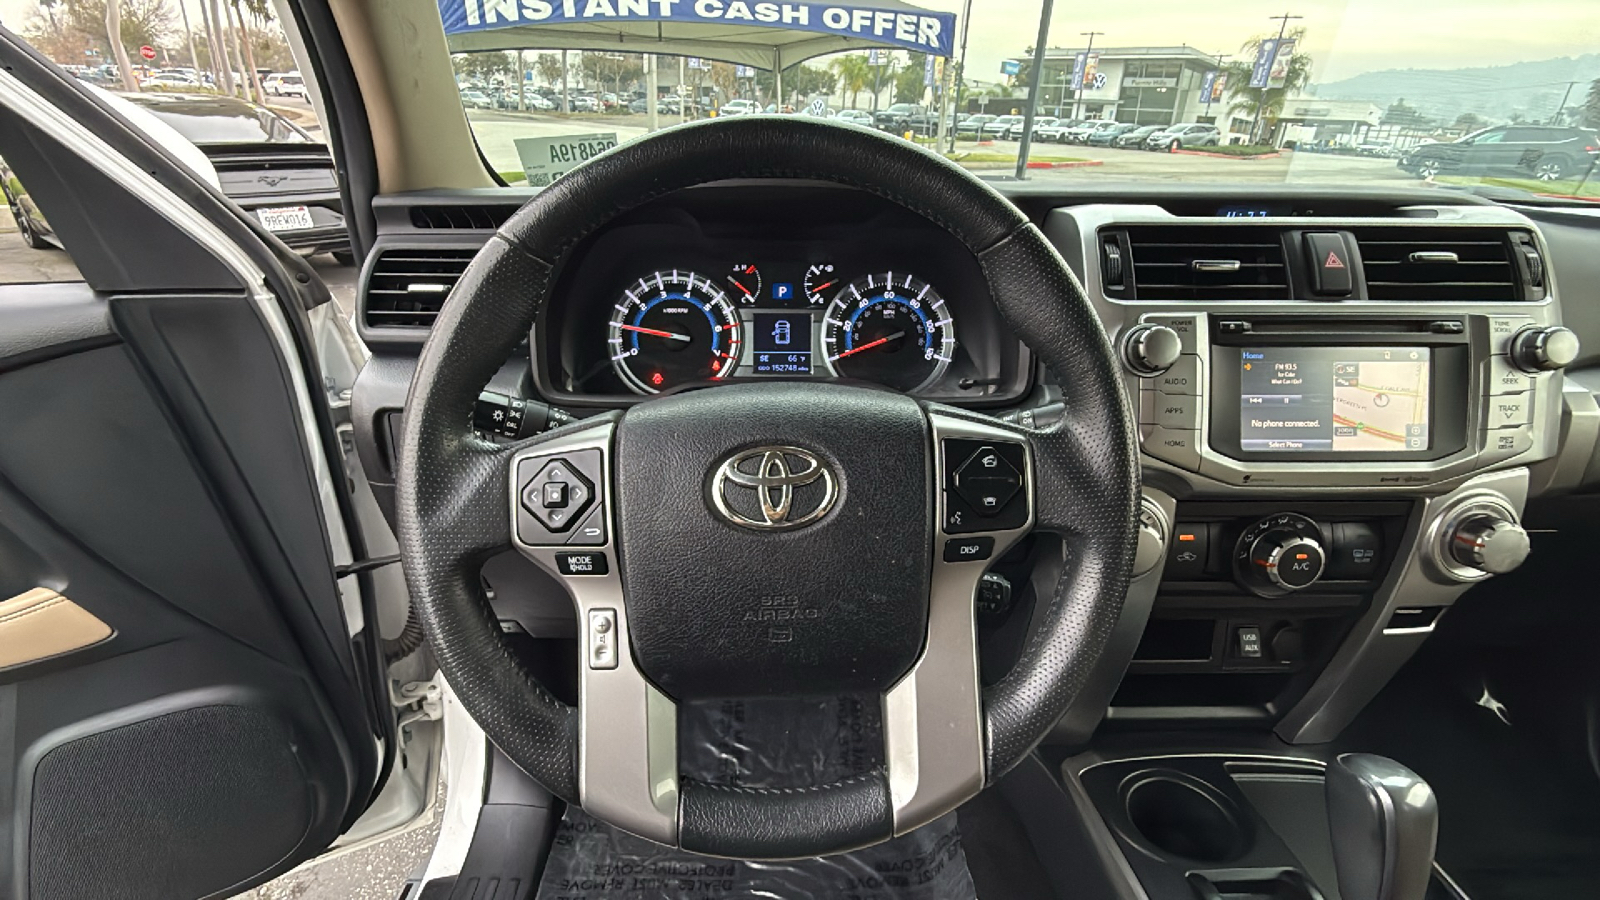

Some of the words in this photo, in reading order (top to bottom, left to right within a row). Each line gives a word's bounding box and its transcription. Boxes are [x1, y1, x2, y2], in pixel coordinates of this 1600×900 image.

[464, 0, 680, 25] INSTANT
[694, 0, 809, 25] CASH
[822, 8, 941, 48] OFFER
[660, 291, 667, 299] 3
[683, 291, 691, 299] 4
[778, 286, 787, 297] P
[883, 291, 895, 299] 60
[640, 302, 648, 311] 2
[703, 303, 712, 311] 5
[859, 298, 869, 308] 40
[909, 298, 920, 309] 80
[714, 325, 722, 333] 6
[843, 320, 853, 332] 20
[630, 348, 638, 356] 0
[1242, 352, 1264, 360] Home
[788, 354, 797, 362] 66
[772, 364, 797, 372] 152748
[1275, 363, 1284, 371] FM
[1251, 420, 1262, 428] No
[1263, 420, 1284, 429] phone
[1284, 419, 1321, 428] connected.
[1268, 441, 1286, 449] Select
[1286, 441, 1303, 449] Phone
[960, 545, 979, 554] DISP
[568, 556, 592, 564] MODE
[1292, 562, 1310, 570] A/C
